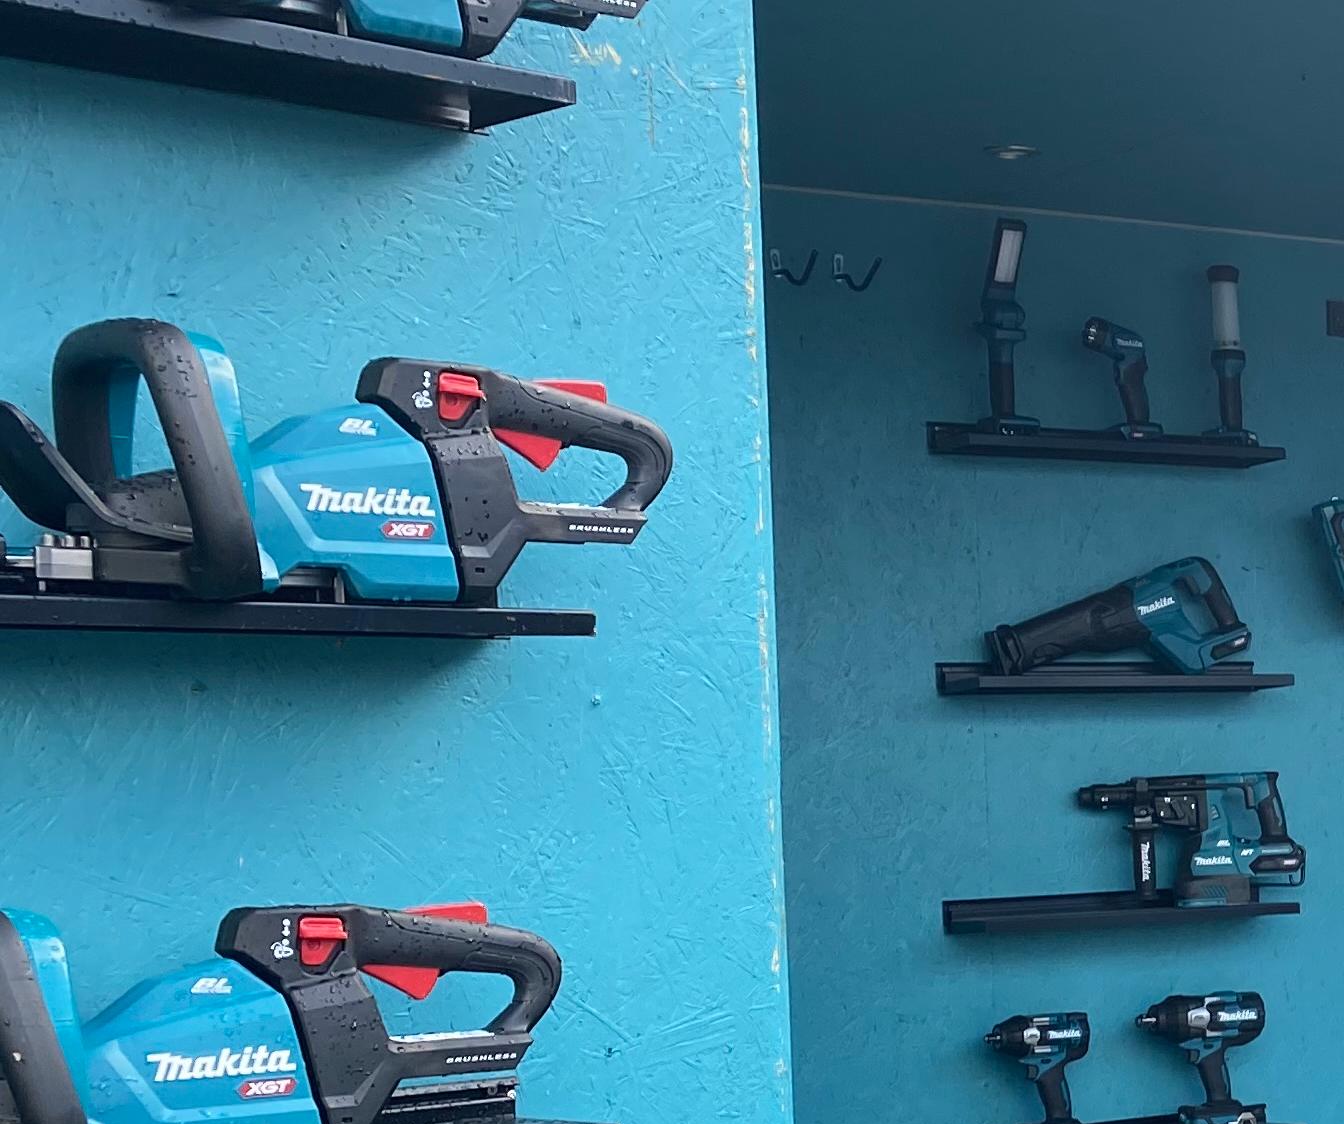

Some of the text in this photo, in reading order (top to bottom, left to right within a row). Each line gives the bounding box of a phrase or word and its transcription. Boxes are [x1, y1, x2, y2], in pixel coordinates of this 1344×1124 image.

[300, 484, 435, 516] Makita
[388, 523, 429, 538] XGT
[569, 524, 634, 534] BRUSHLESS
[1138, 597, 1175, 615] Makita
[1141, 842, 1151, 882] Makita
[1194, 855, 1232, 865] Makita
[1217, 1010, 1257, 1022] Makita
[1048, 1029, 1081, 1039] Makita
[146, 1045, 297, 1082] Makita
[446, 1052, 517, 1064] BRUSHLESS
[245, 1077, 293, 1095] XGT
